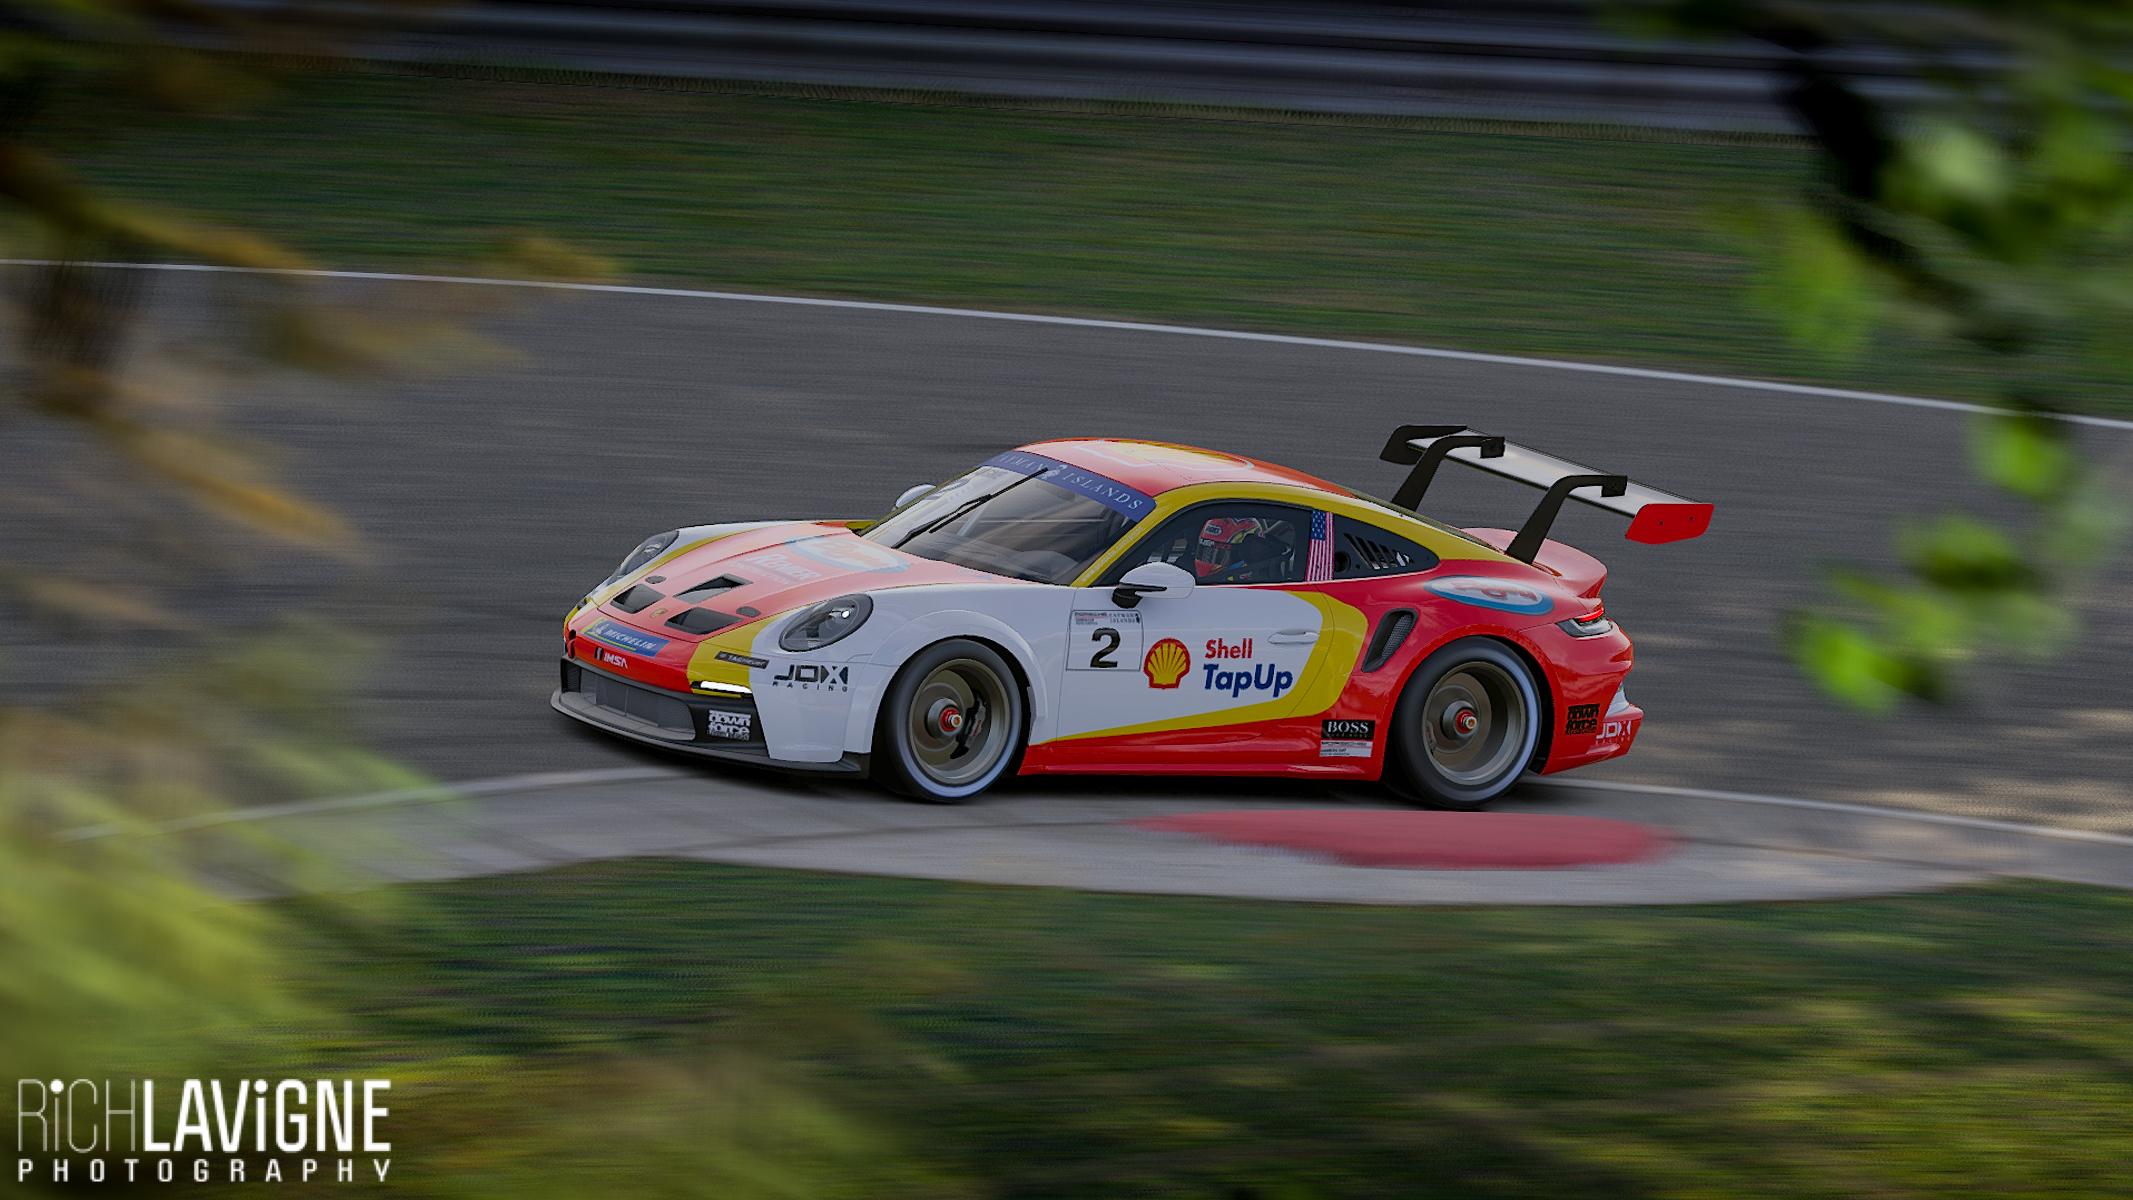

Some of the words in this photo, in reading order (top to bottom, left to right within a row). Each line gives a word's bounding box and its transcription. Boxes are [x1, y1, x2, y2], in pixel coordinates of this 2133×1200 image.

[1064, 472, 1142, 510] ISLANDS
[605, 629, 657, 650] MICHELIN
[1090, 627, 1120, 668] 2
[1205, 638, 1253, 659] Shell
[603, 652, 628, 669] IMSA
[772, 681, 848, 692] RACING
[1203, 664, 1293, 698] TapUp
[1328, 721, 1369, 733] BOSS
